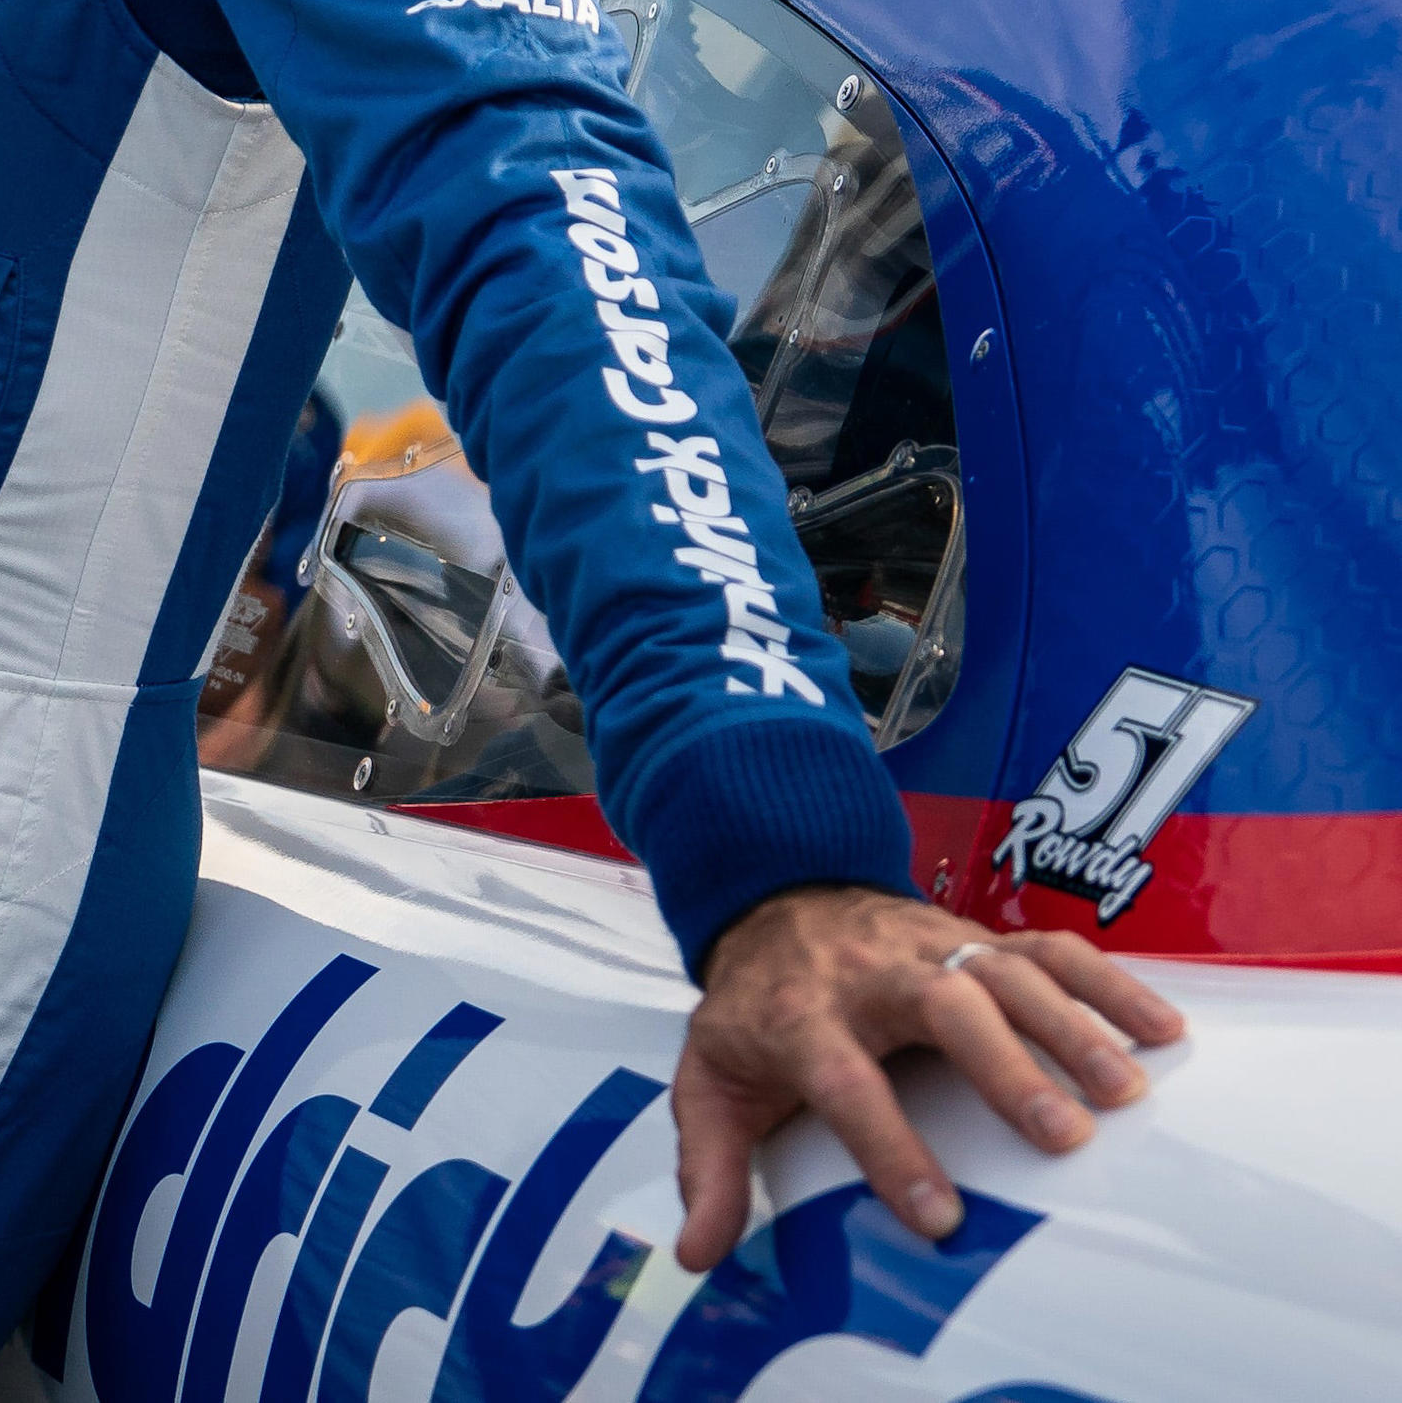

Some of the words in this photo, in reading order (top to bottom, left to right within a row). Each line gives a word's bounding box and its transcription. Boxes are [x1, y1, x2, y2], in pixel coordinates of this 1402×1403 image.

[634, 431, 825, 709] Hndrick
[1033, 663, 1260, 854] 51
[992, 795, 1155, 925] Rowdy
